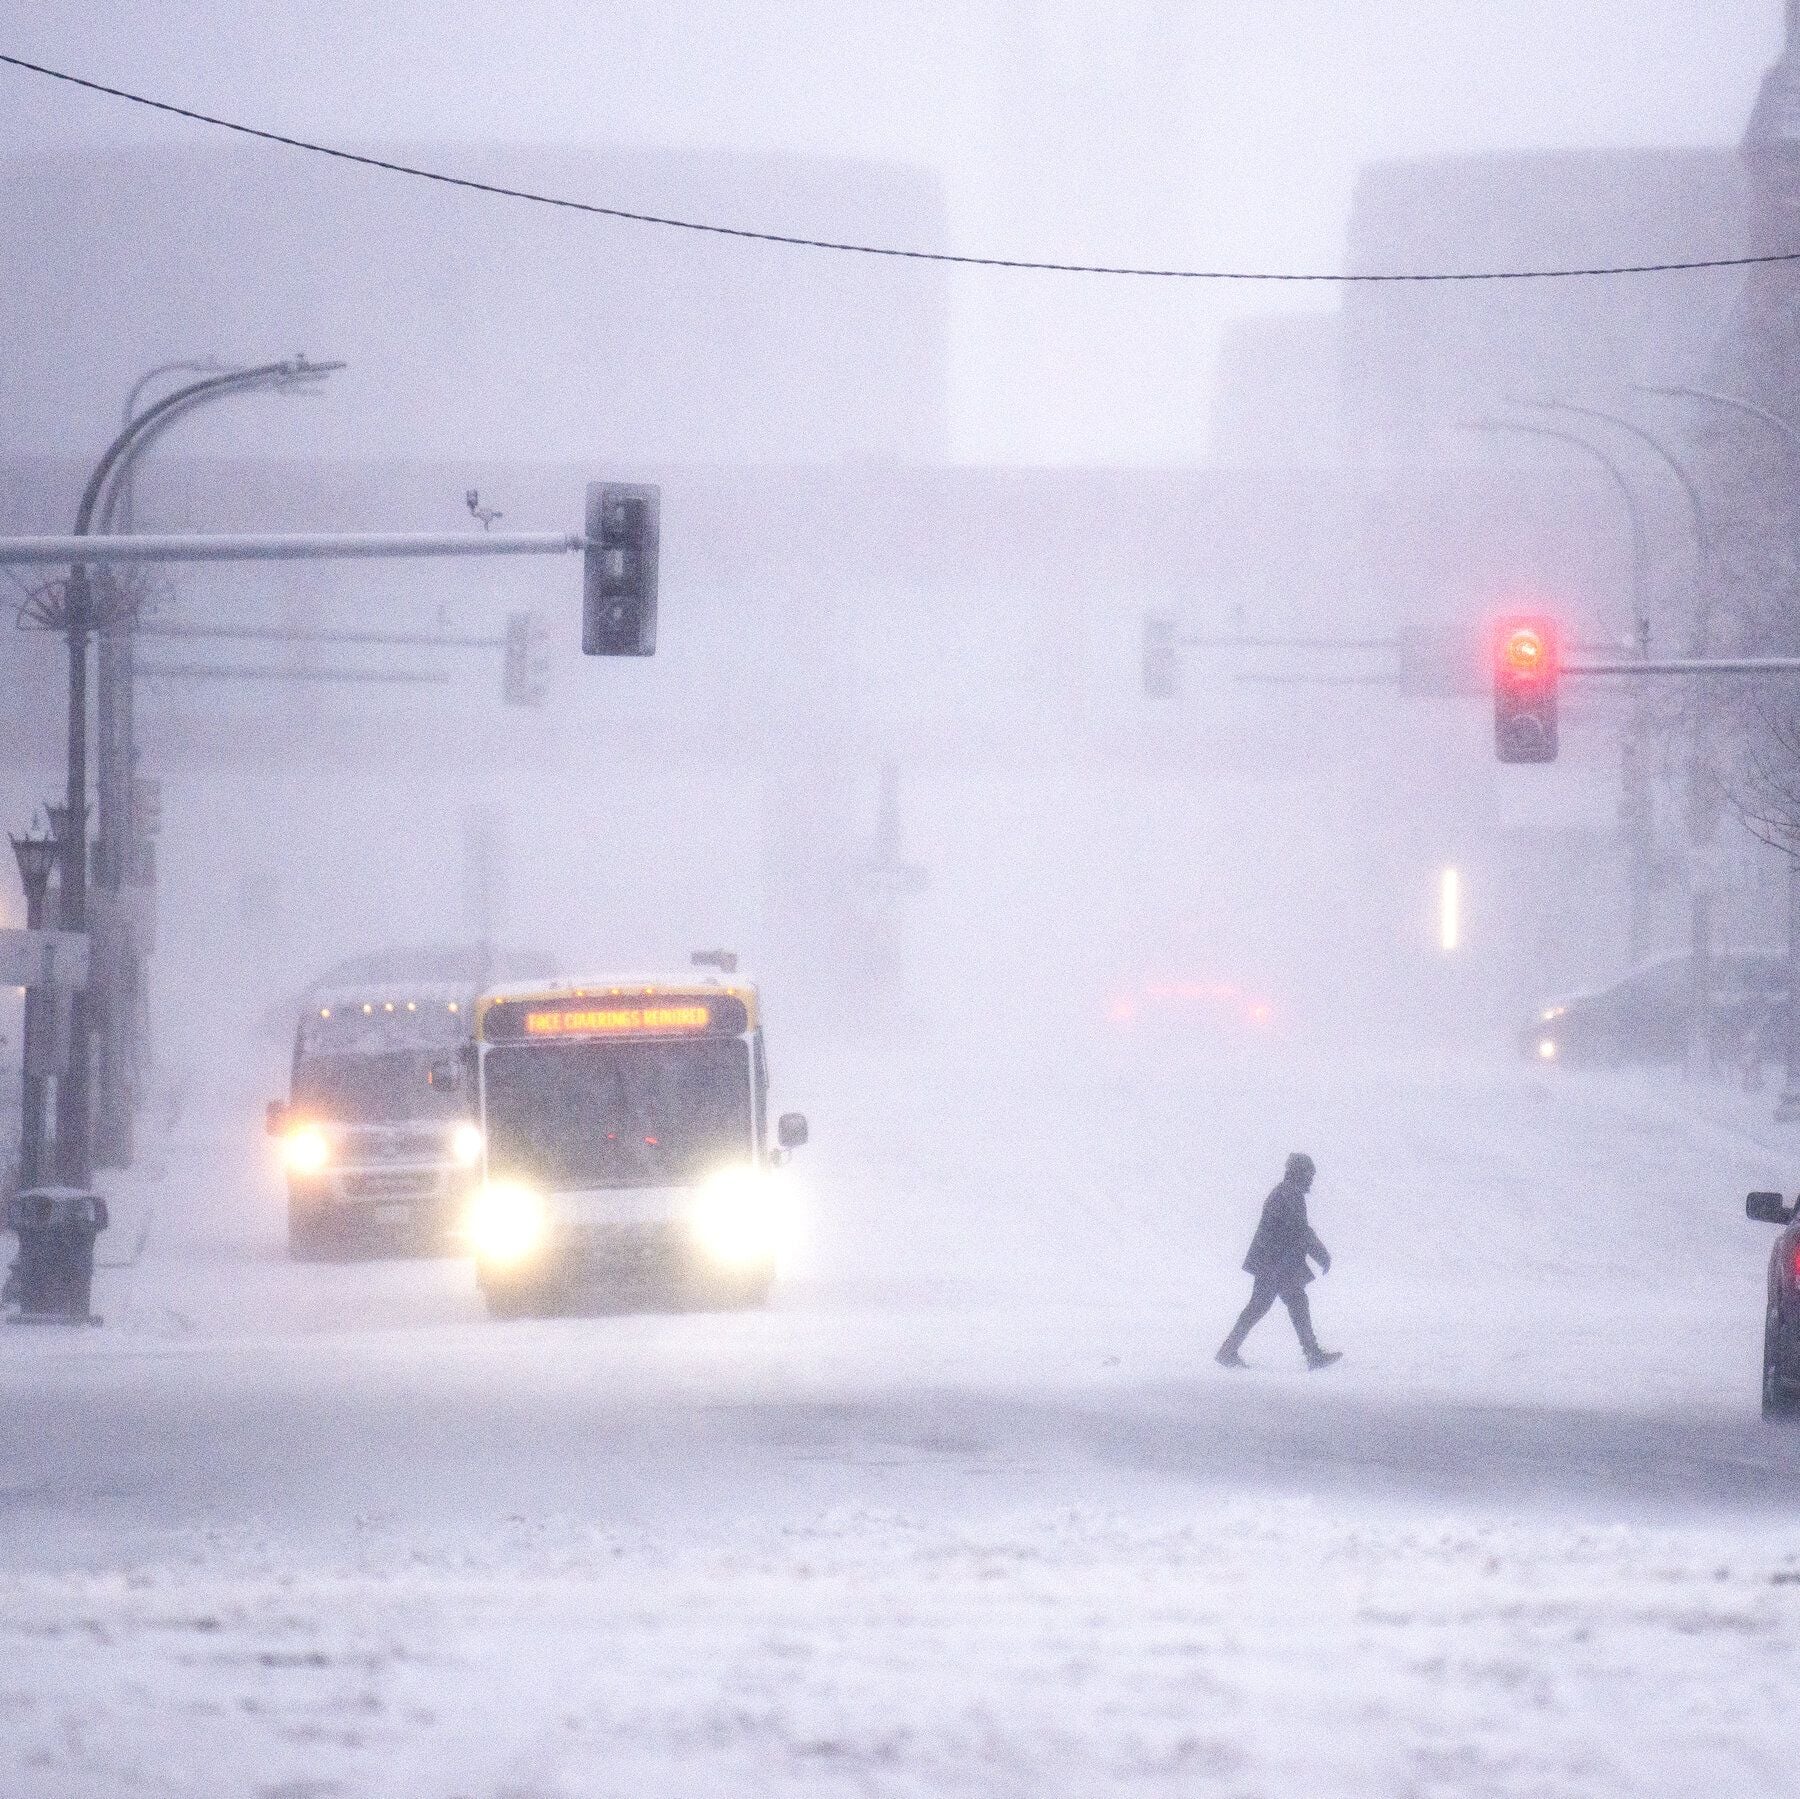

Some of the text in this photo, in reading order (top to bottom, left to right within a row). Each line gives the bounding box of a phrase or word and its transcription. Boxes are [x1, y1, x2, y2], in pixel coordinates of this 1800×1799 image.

[527, 1007, 706, 1031] FACE COVERINGS REQUIRED
